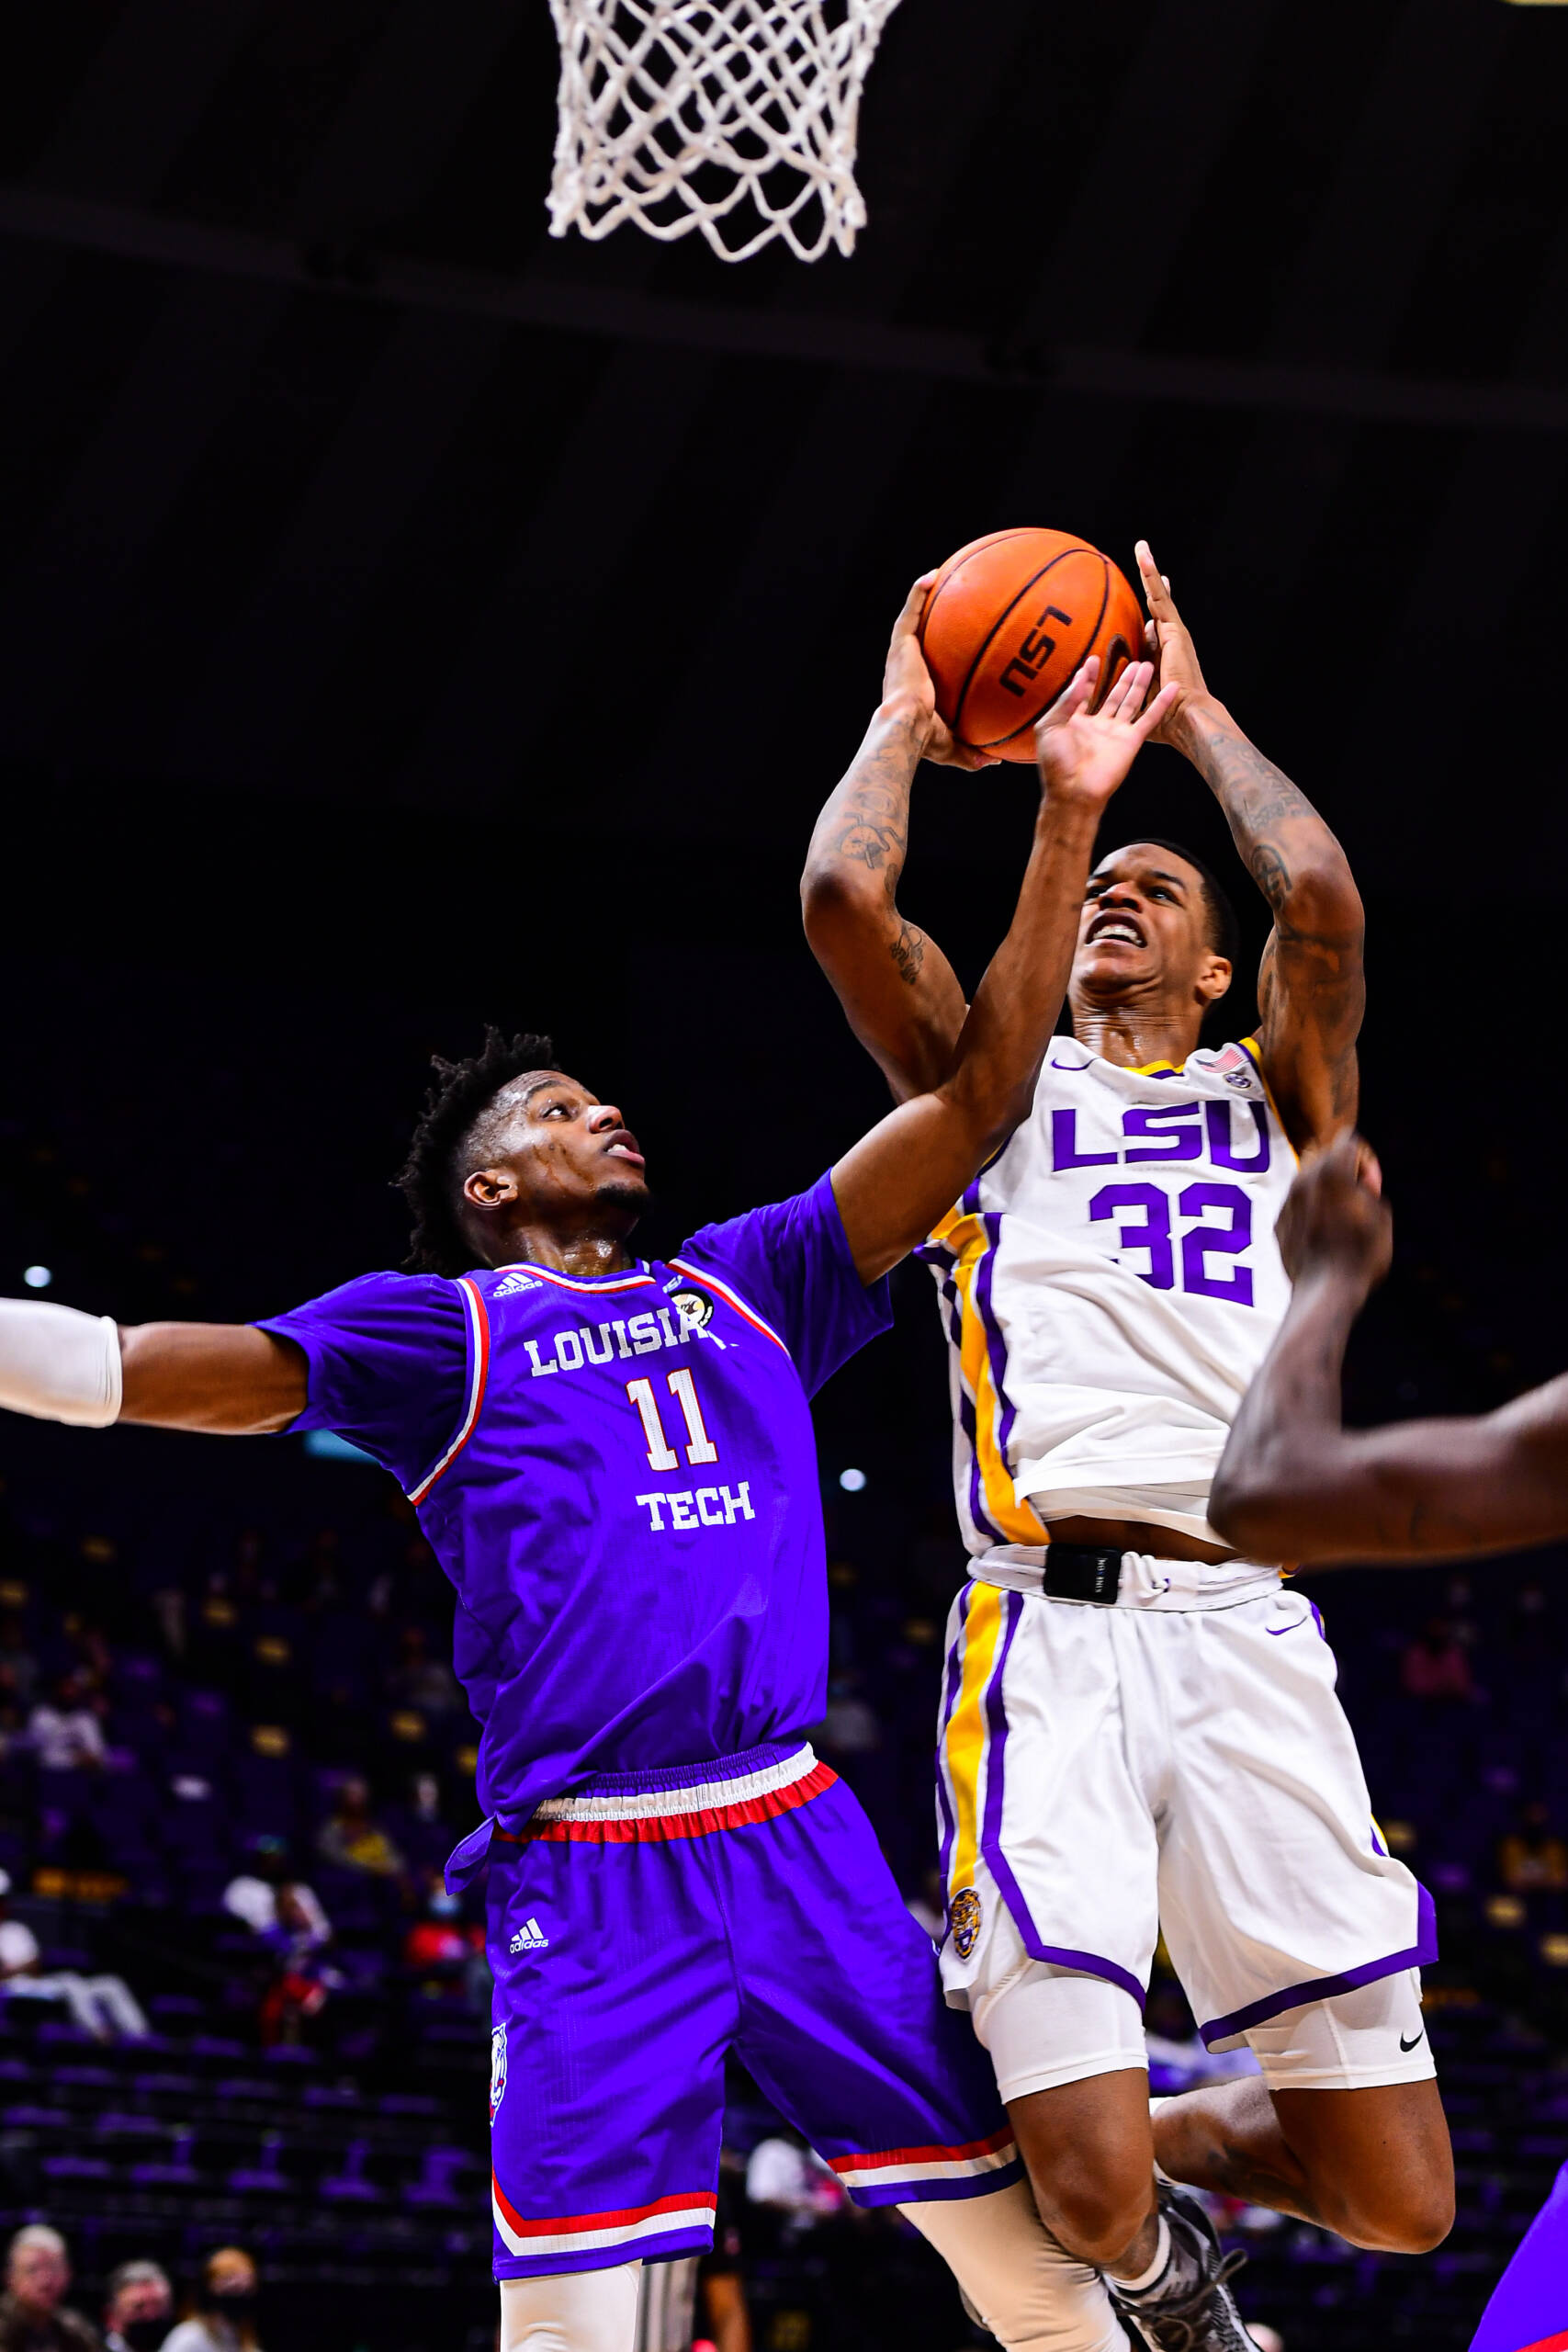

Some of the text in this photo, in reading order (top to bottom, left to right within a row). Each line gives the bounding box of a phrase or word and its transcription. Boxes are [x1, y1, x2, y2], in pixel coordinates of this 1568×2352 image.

[999, 605, 1074, 698] LSU
[1052, 1100, 1270, 1172] LSU
[1089, 1182, 1254, 1307] 32
[493, 1280, 543, 1297] adidas
[626, 1367, 718, 1472] 11
[636, 1481, 756, 1532] TECH
[510, 1939, 548, 1953] adidas
